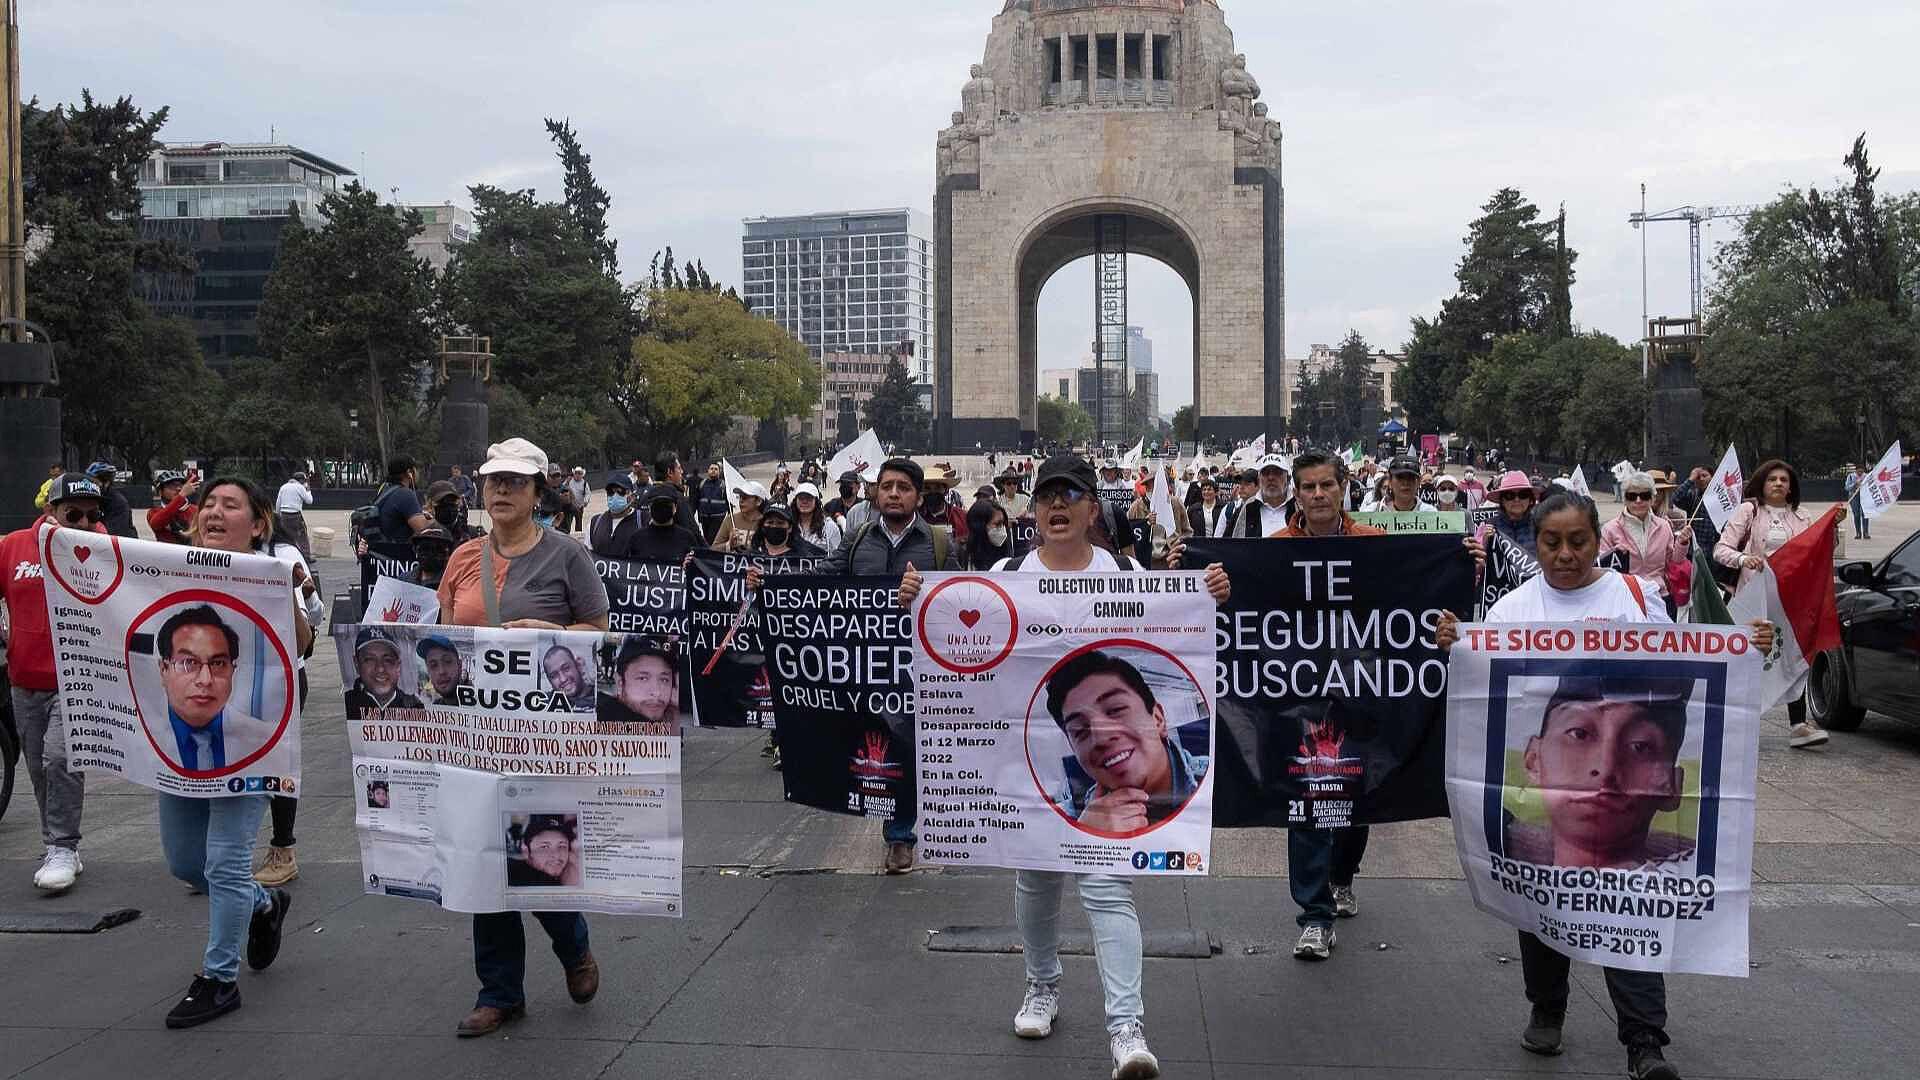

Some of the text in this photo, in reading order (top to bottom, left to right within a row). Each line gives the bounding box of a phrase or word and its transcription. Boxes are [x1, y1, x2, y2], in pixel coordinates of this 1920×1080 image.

[1097, 490, 1132, 500] ECURSOS
[1394, 516, 1427, 530] hasta
[1436, 516, 1449, 530] la
[186, 550, 232, 568] CAMINO
[723, 554, 793, 577] BASTA
[86, 567, 100, 581] LUZ
[595, 560, 620, 579] OR
[626, 563, 650, 582] LA
[1038, 576, 1199, 594] COLECTIVO UNA LUZ EN EL
[1293, 560, 1353, 602] TE
[54, 606, 93, 619] Ignacio
[1093, 601, 1145, 618] CAMINO
[56, 621, 102, 637] Santiago
[1215, 608, 1441, 651] SEGUIMOS
[59, 636, 90, 648] Pérez
[693, 631, 707, 648] A
[713, 631, 751, 651] LAS
[1465, 629, 1749, 656] TE SIGO BUSCANDO
[61, 651, 128, 670] Desaparecido
[483, 649, 531, 675] SE
[953, 656, 985, 664] CDMX
[63, 667, 118, 682] el 12 Junio
[920, 671, 996, 683] Dereck Jair
[1215, 659, 1447, 699] BUSCANDO
[65, 682, 94, 692] 2020
[919, 689, 963, 699] Eslava
[67, 697, 138, 717] En Col. Unidad
[457, 686, 571, 713] BUSCA
[782, 684, 915, 715] CRUEL Y COB
[920, 705, 975, 715] Jiménez
[460, 712, 470, 728] DE
[472, 715, 539, 735] TAMAULIPAS
[542, 719, 558, 735] LO
[920, 720, 1010, 733] Desaparecido
[363, 725, 377, 742] SE
[379, 725, 394, 742] LO
[397, 725, 447, 746] LLEVARON
[449, 730, 471, 753] VIVO,
[472, 733, 485, 752] LO
[487, 734, 529, 757] QUIERO
[533, 738, 562, 759] VIVO,
[565, 739, 598, 758] SANO
[599, 740, 609, 758] Y
[921, 737, 996, 747] el 12 Marzo
[71, 742, 125, 759] Magdalena
[437, 749, 471, 767] HAGO
[921, 753, 953, 764] 2022
[369, 764, 389, 774] FGJ
[922, 769, 983, 780] En la Col.
[848, 791, 859, 805] 21
[922, 785, 998, 798] Ampliación,
[922, 801, 1020, 815] Miguel Hidalgo,
[1288, 800, 1305, 816] 21
[1312, 808, 1353, 817] NACIONAL
[1313, 800, 1354, 810] MARCHA
[979, 817, 1025, 830] Tlalpan
[923, 833, 988, 844] Ciudad de
[923, 848, 970, 859] México
[1489, 855, 1715, 898] RODRIGO RICARDO
[1556, 892, 1704, 921] FERNANDEZ
[1539, 912, 1660, 939] FECHA DE DESAPARICIÓN
[1539, 921, 1663, 957] 28-SEP-2019
